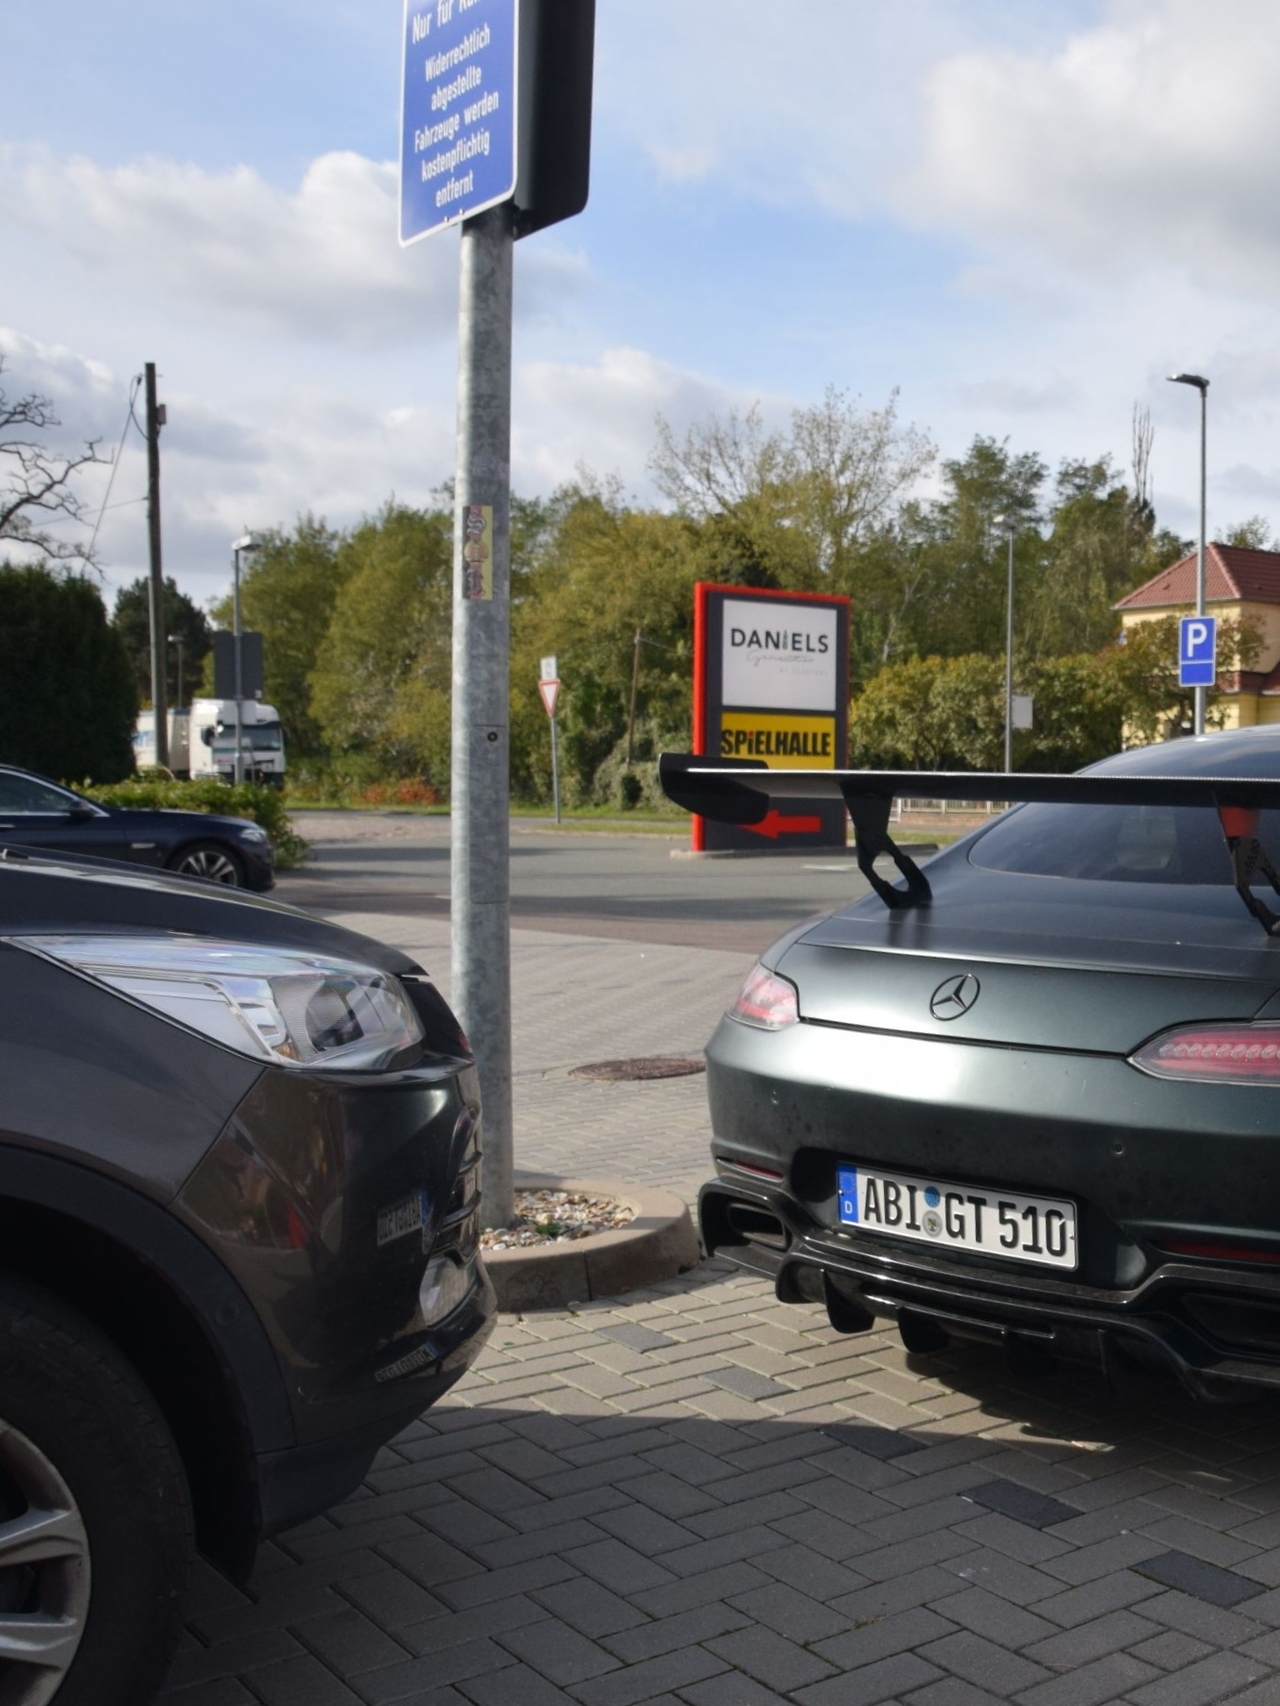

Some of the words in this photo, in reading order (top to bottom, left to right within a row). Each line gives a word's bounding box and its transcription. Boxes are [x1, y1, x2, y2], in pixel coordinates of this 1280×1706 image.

[412, 13, 433, 44] Nur
[425, 23, 491, 82] Widerrechtlich
[431, 65, 482, 111] abgestellte
[414, 114, 460, 153] Fahrzeuge
[463, 91, 499, 125] werden
[421, 130, 491, 182] kostenpflichtig
[436, 169, 474, 208] entfernt
[1187, 622, 1208, 658] P
[844, 1200, 853, 1215] D
[864, 1177, 921, 1232] ABI
[945, 1192, 987, 1243] GT
[998, 1200, 1068, 1257] 510
